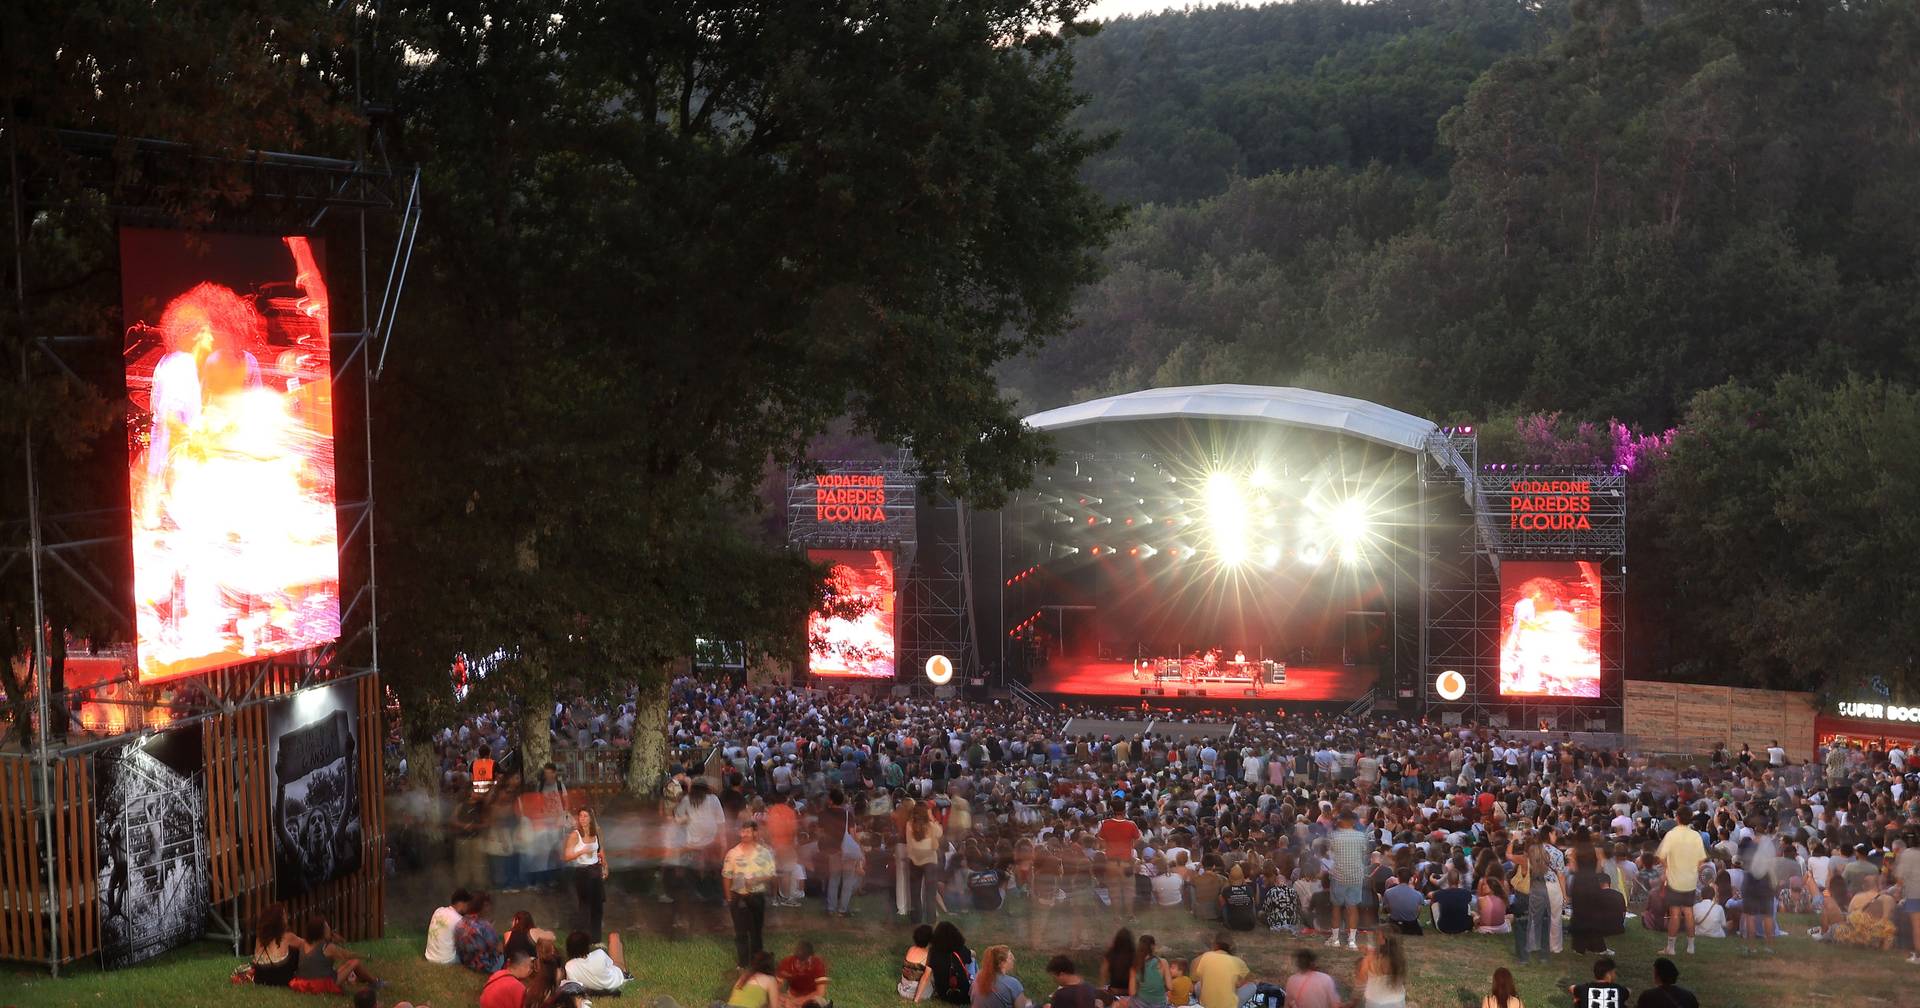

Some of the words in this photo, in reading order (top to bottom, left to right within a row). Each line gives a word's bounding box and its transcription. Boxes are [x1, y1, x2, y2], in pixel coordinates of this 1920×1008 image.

[816, 475, 884, 487] VODAFONE
[1511, 481, 1591, 494] VODAFONE
[817, 489, 885, 504] PAREDES
[1511, 497, 1591, 512] PAREDES
[824, 505, 886, 522] COURA
[1511, 513, 1518, 528] DE
[1520, 513, 1591, 530] COURA
[1838, 702, 1884, 718] SUPER
[1887, 705, 1920, 722] BOC
